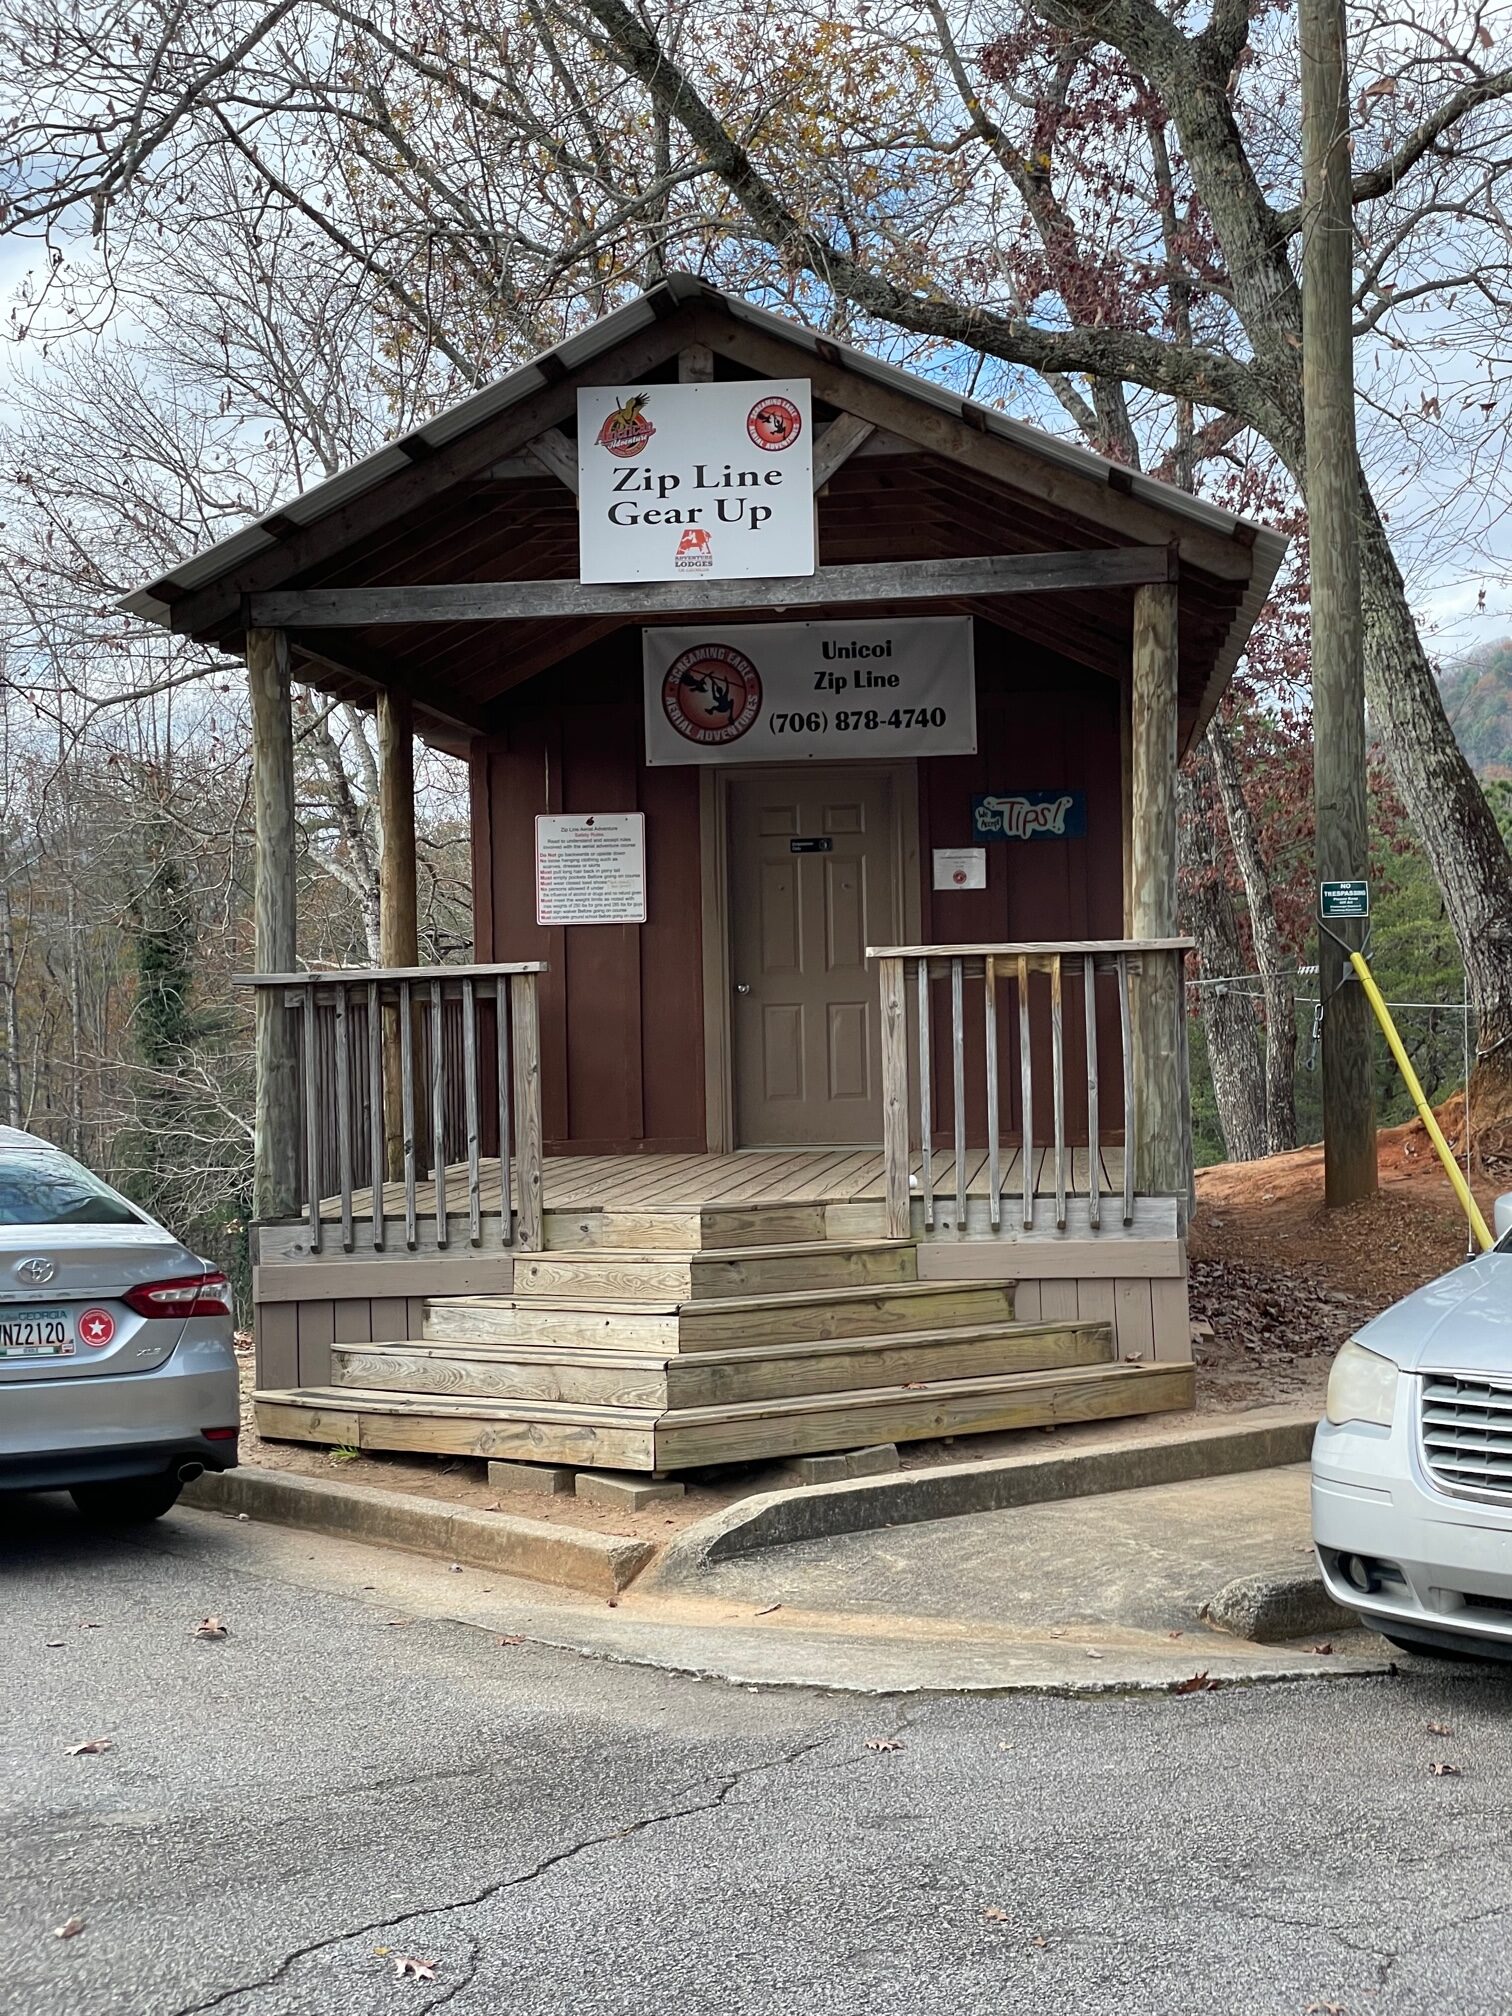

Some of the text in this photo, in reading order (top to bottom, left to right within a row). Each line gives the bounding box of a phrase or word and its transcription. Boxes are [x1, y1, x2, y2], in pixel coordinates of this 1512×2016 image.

[612, 465, 783, 498] Zip Line
[607, 498, 772, 530] Gear Up
[822, 640, 892, 659] Unicoi
[668, 647, 756, 685] SCREAMING EAGLE
[814, 670, 900, 694] Zip Line
[665, 695, 758, 741] AERIAL ADVENTURES
[769, 707, 946, 735] (706) 878-4740
[18, 1311, 68, 1320] GEORGIA
[0, 1321, 65, 1346] NZ2120
